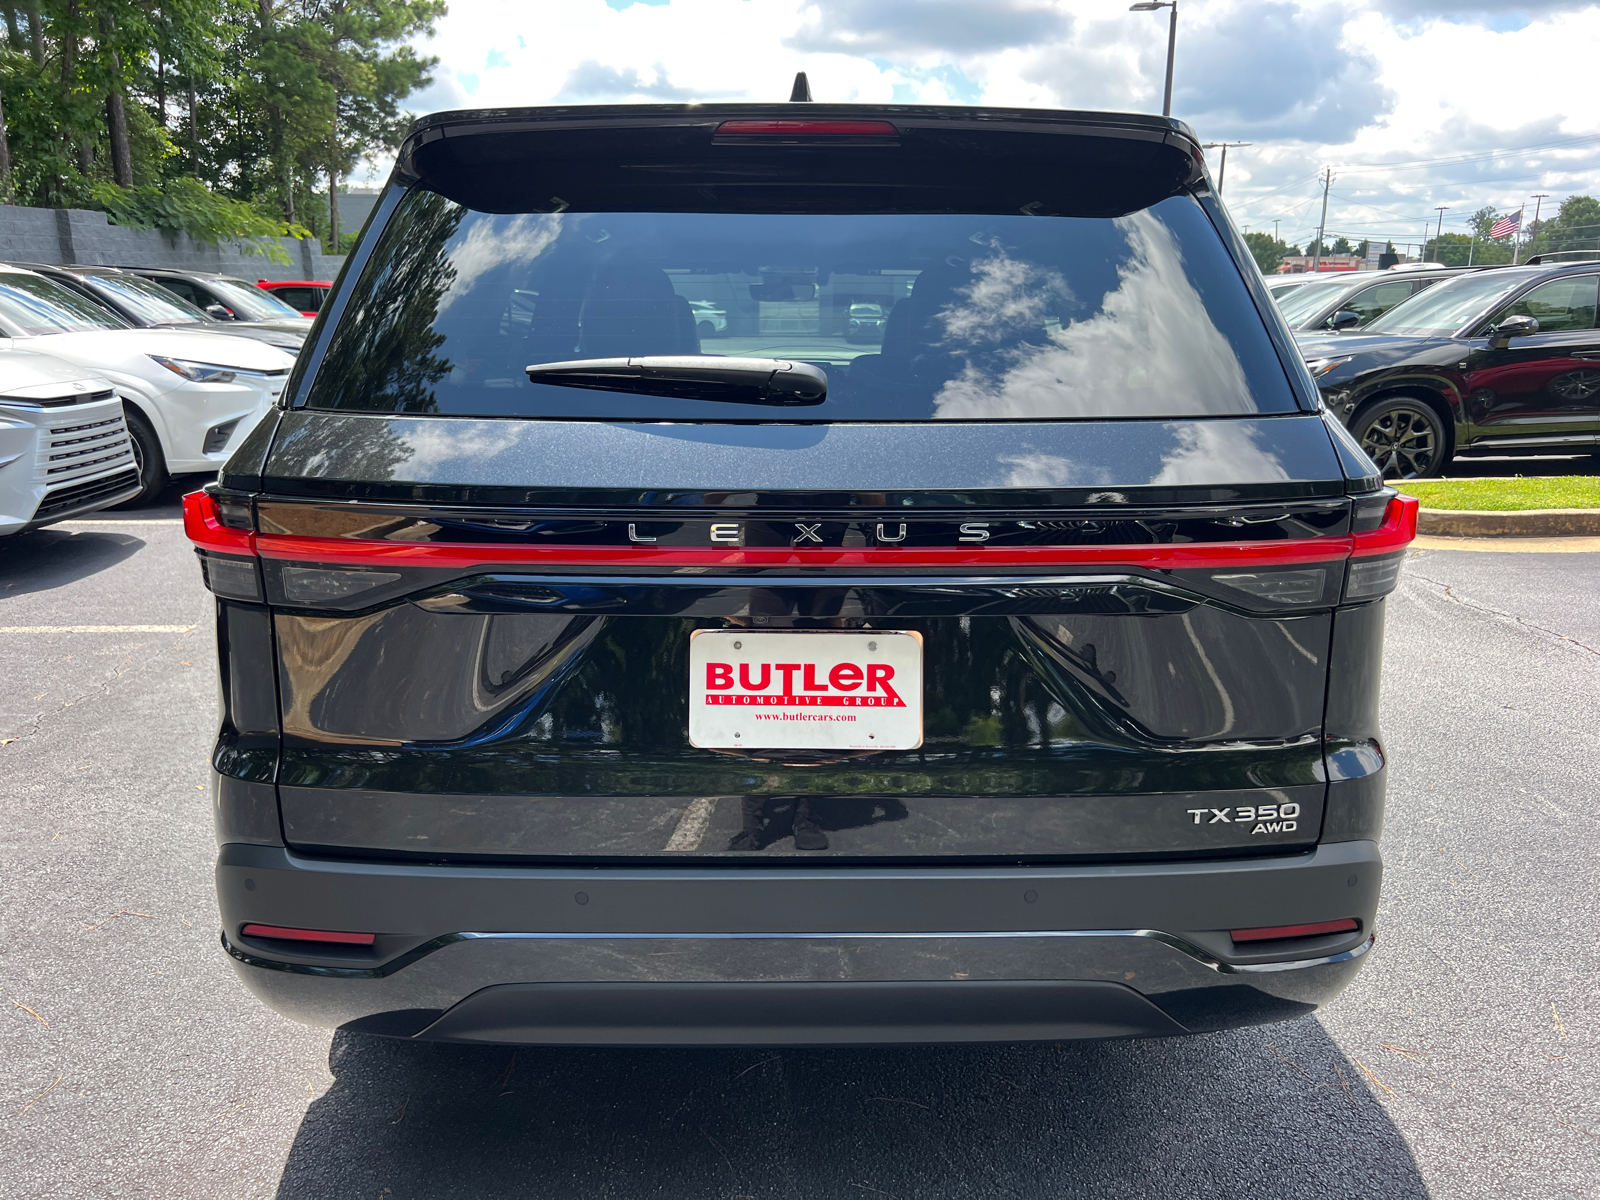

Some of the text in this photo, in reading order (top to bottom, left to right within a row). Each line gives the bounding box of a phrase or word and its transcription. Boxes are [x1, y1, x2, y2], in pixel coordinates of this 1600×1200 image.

[628, 523, 991, 542] LEXUS
[706, 695, 899, 706] AUTOMOTIVE GROUP
[755, 712, 857, 722] www.butlercars.com
[1187, 803, 1300, 825] TX 350
[1251, 821, 1297, 834] AWD
